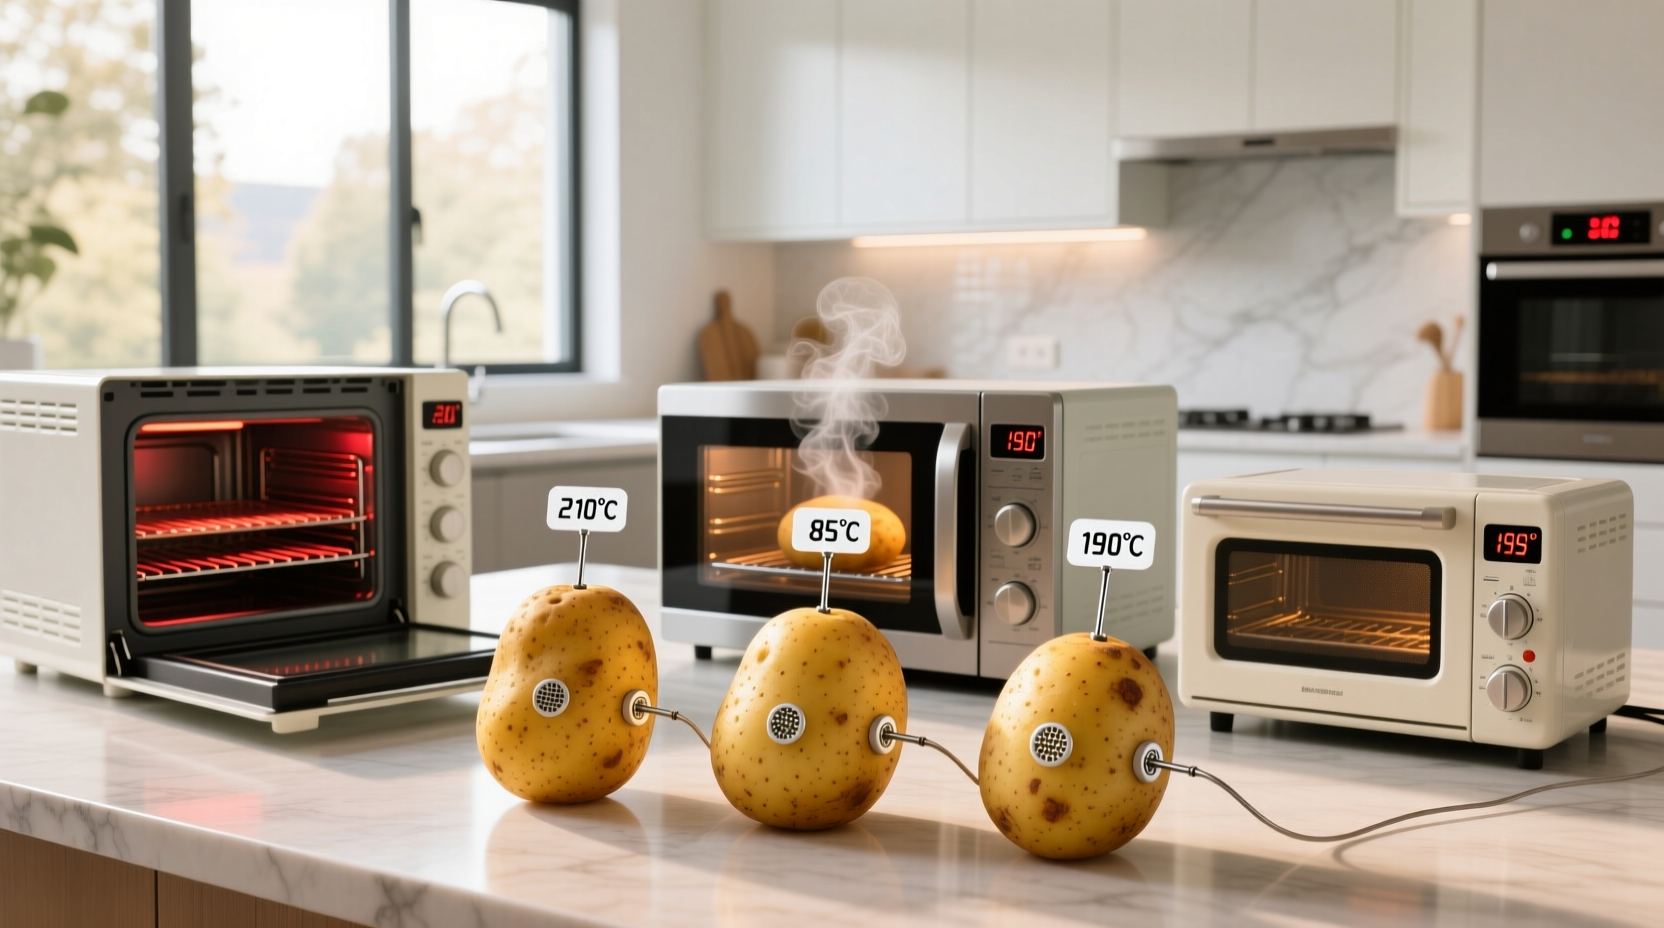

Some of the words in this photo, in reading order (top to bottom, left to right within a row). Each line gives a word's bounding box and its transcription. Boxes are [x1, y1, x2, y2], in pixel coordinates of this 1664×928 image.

[558, 497, 618, 520] 210°C
[809, 518, 860, 542] 85°C
[1082, 531, 1144, 557] 190°C
